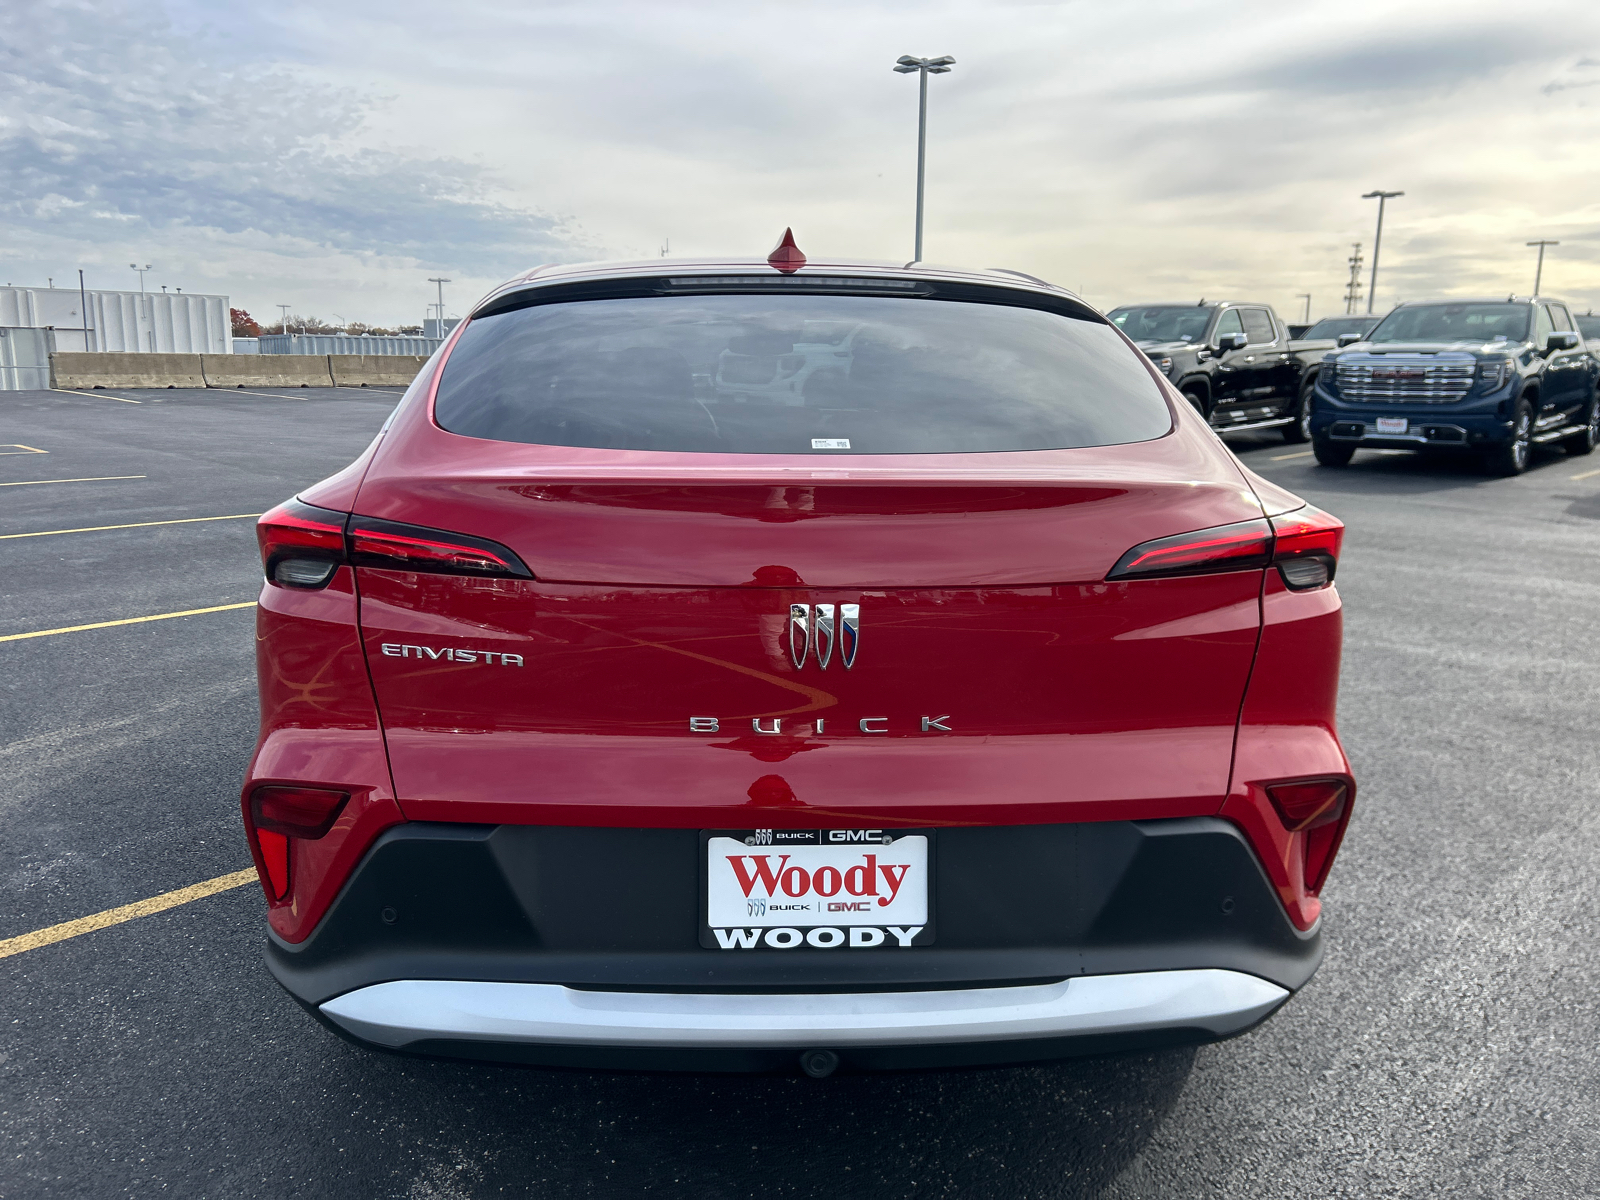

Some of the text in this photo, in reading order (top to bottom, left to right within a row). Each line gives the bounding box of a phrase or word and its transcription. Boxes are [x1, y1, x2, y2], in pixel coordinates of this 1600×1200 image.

[381, 642, 524, 667] ENVISTA
[689, 715, 952, 734] BUICK
[829, 829, 883, 841] GMC
[725, 854, 911, 907] Woody
[827, 901, 871, 912] GMC
[713, 926, 923, 949] WOODY
